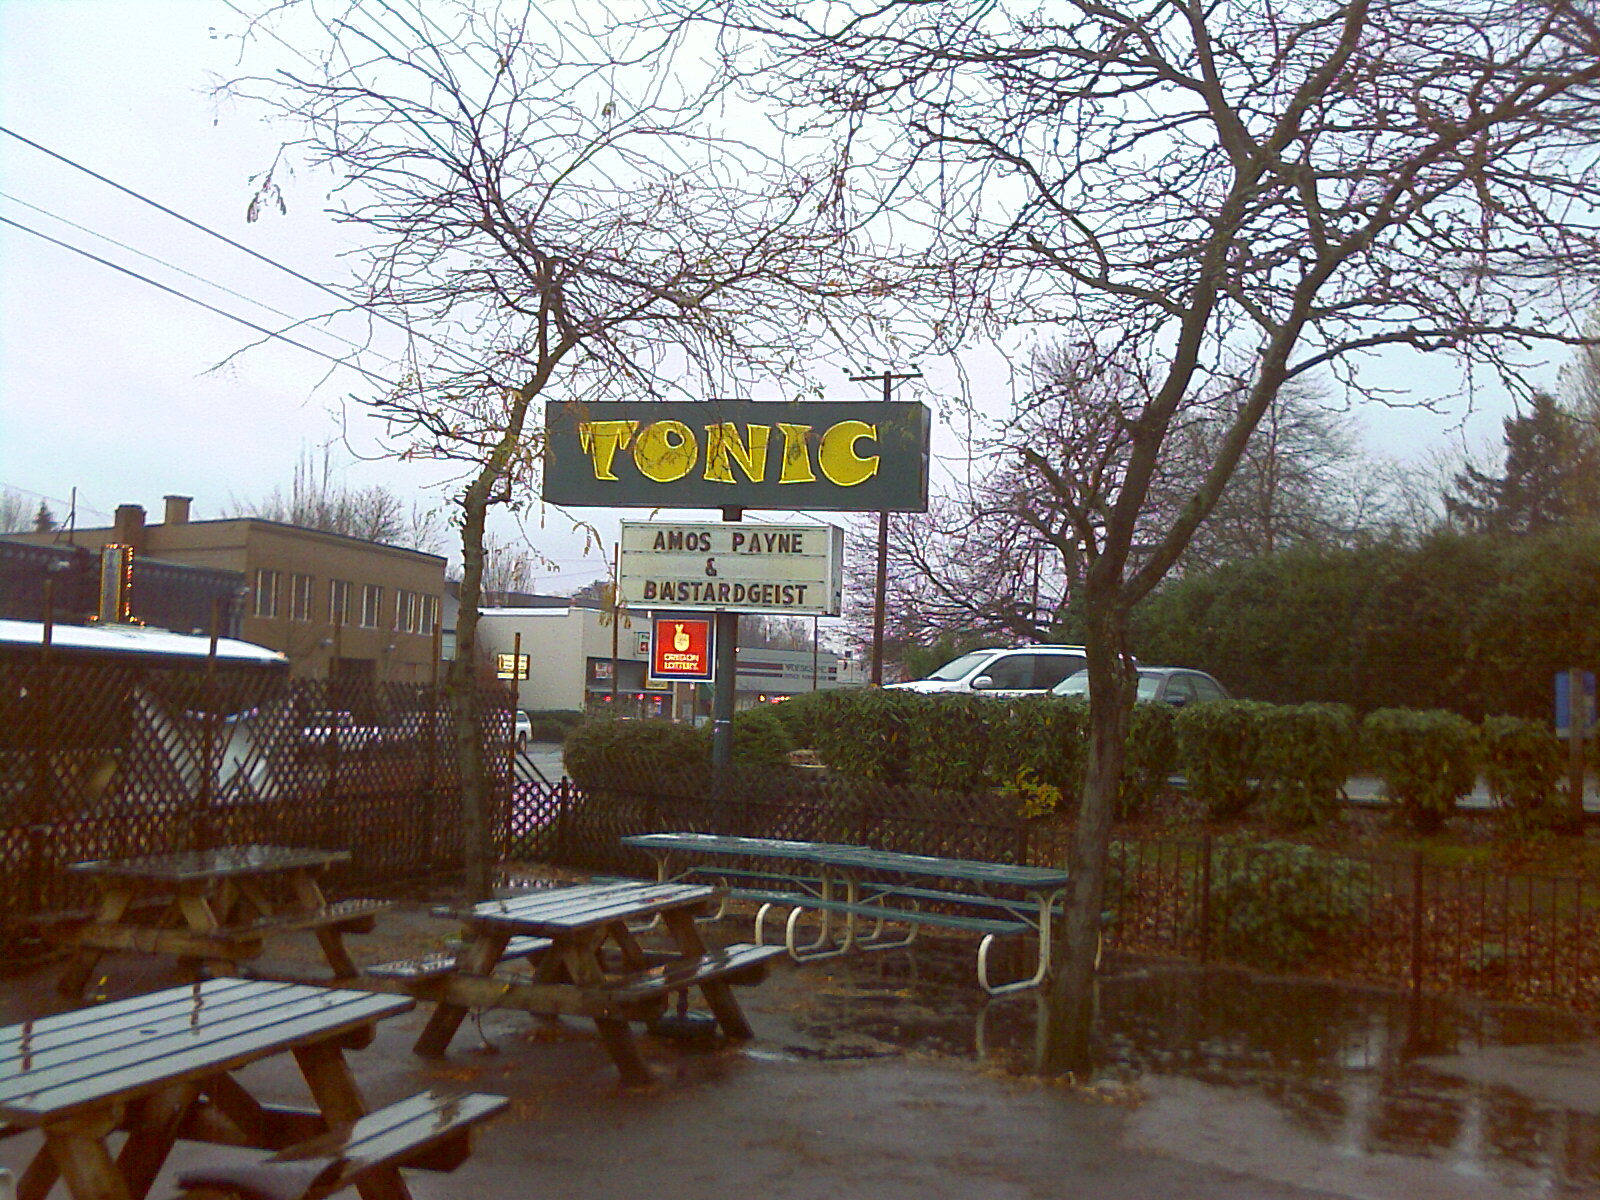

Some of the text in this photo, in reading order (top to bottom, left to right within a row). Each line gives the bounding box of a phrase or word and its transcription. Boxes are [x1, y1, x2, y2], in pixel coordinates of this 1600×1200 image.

[578, 420, 880, 487] TONIC
[653, 531, 803, 554] AMOS PAYNE
[705, 558, 717, 577] &
[644, 580, 808, 605] BASTARDGEIST
[664, 653, 699, 662] OREGON
